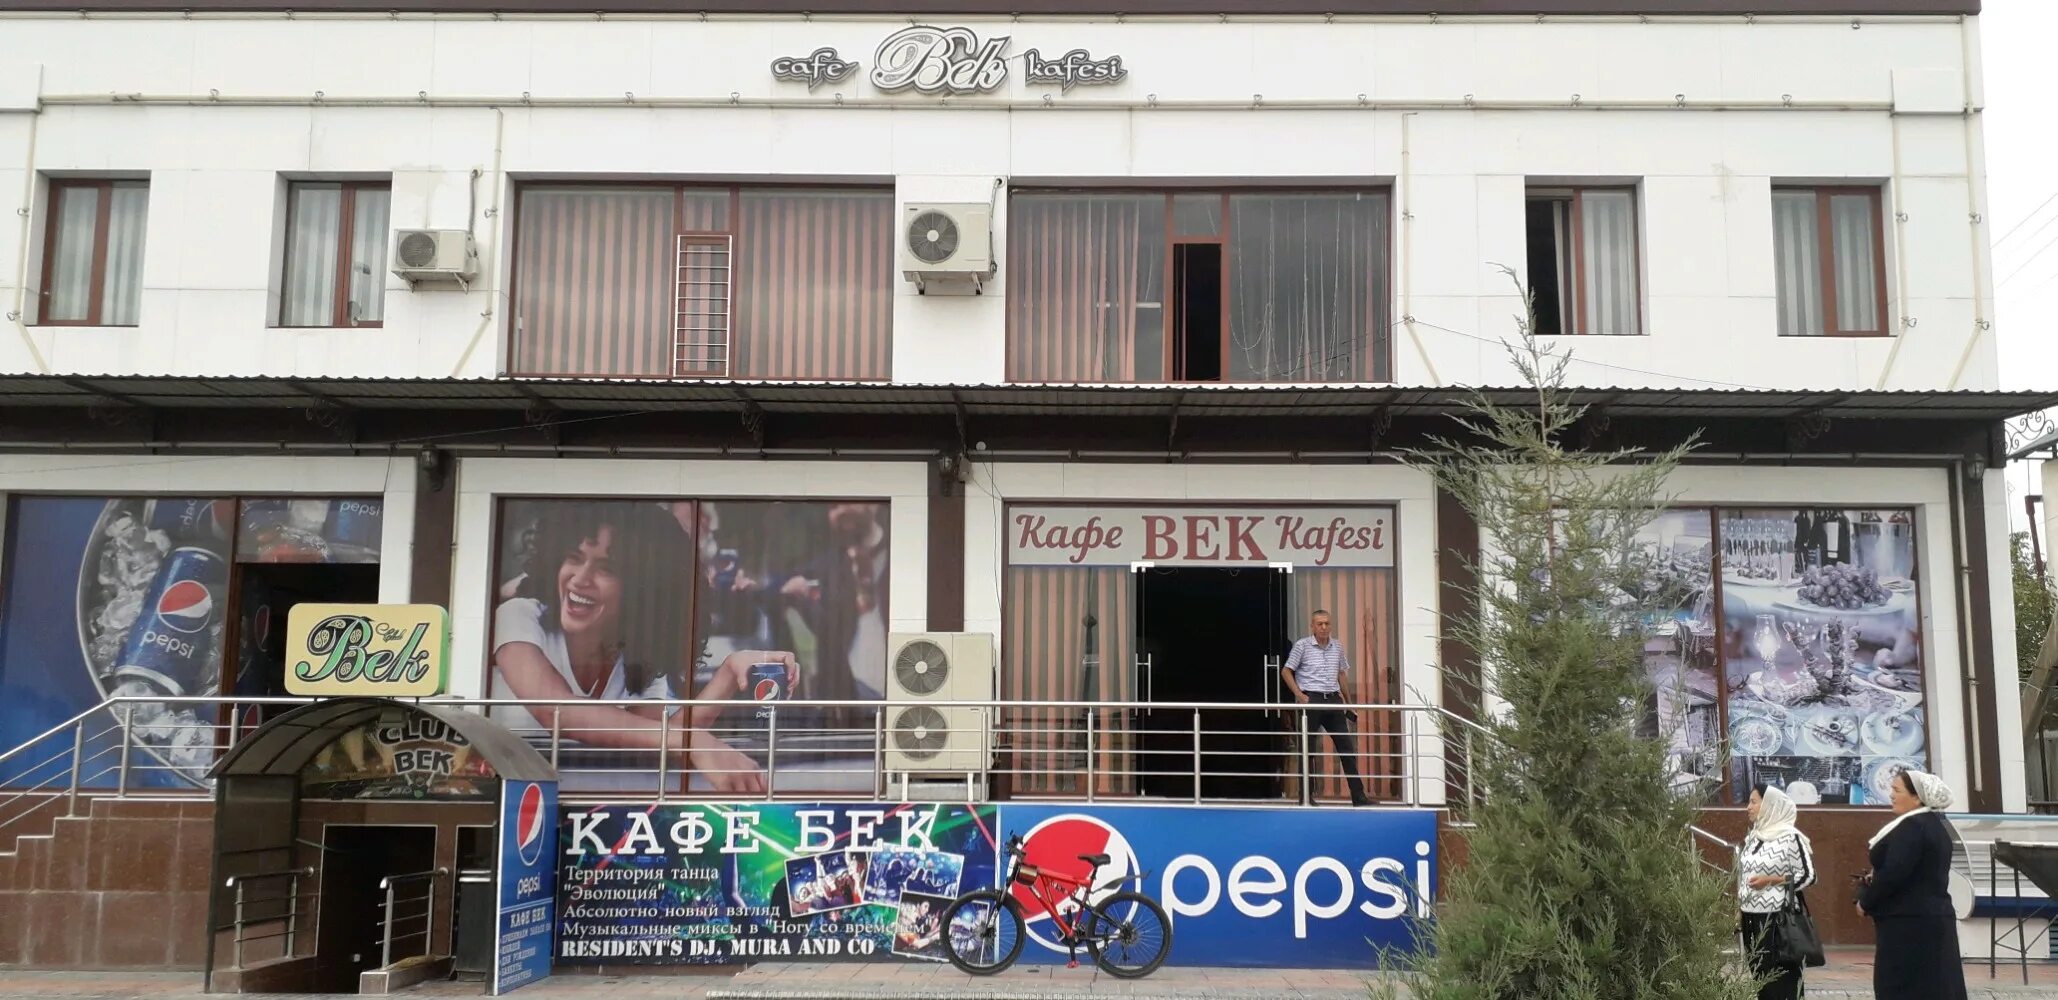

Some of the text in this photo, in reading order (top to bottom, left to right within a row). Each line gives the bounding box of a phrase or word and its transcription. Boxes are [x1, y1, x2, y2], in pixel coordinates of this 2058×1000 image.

[772, 26, 1124, 95] cafe Bek kafesi
[1015, 513, 1123, 563] Кафе
[1275, 515, 1384, 565] Kafesi
[140, 631, 195, 658] pepsi
[295, 615, 430, 683] Bek
[394, 749, 454, 775] BEK
[565, 810, 939, 855] КАФЕ БЕК
[517, 872, 541, 899] pepsi
[565, 866, 719, 884] Территория танца
[564, 883, 665, 902] "Эволюция"
[1161, 840, 1430, 938] pepsi
[563, 904, 780, 918] Абсолютно новый взгляд
[562, 922, 681, 939] Музыкальные
[688, 924, 742, 935] миксы
[750, 924, 759, 935] в
[766, 919, 812, 938] "Ногу
[819, 924, 838, 934] со
[730, 939, 791, 956] MURA
[797, 938, 841, 955] AND
[847, 938, 875, 955] CO
